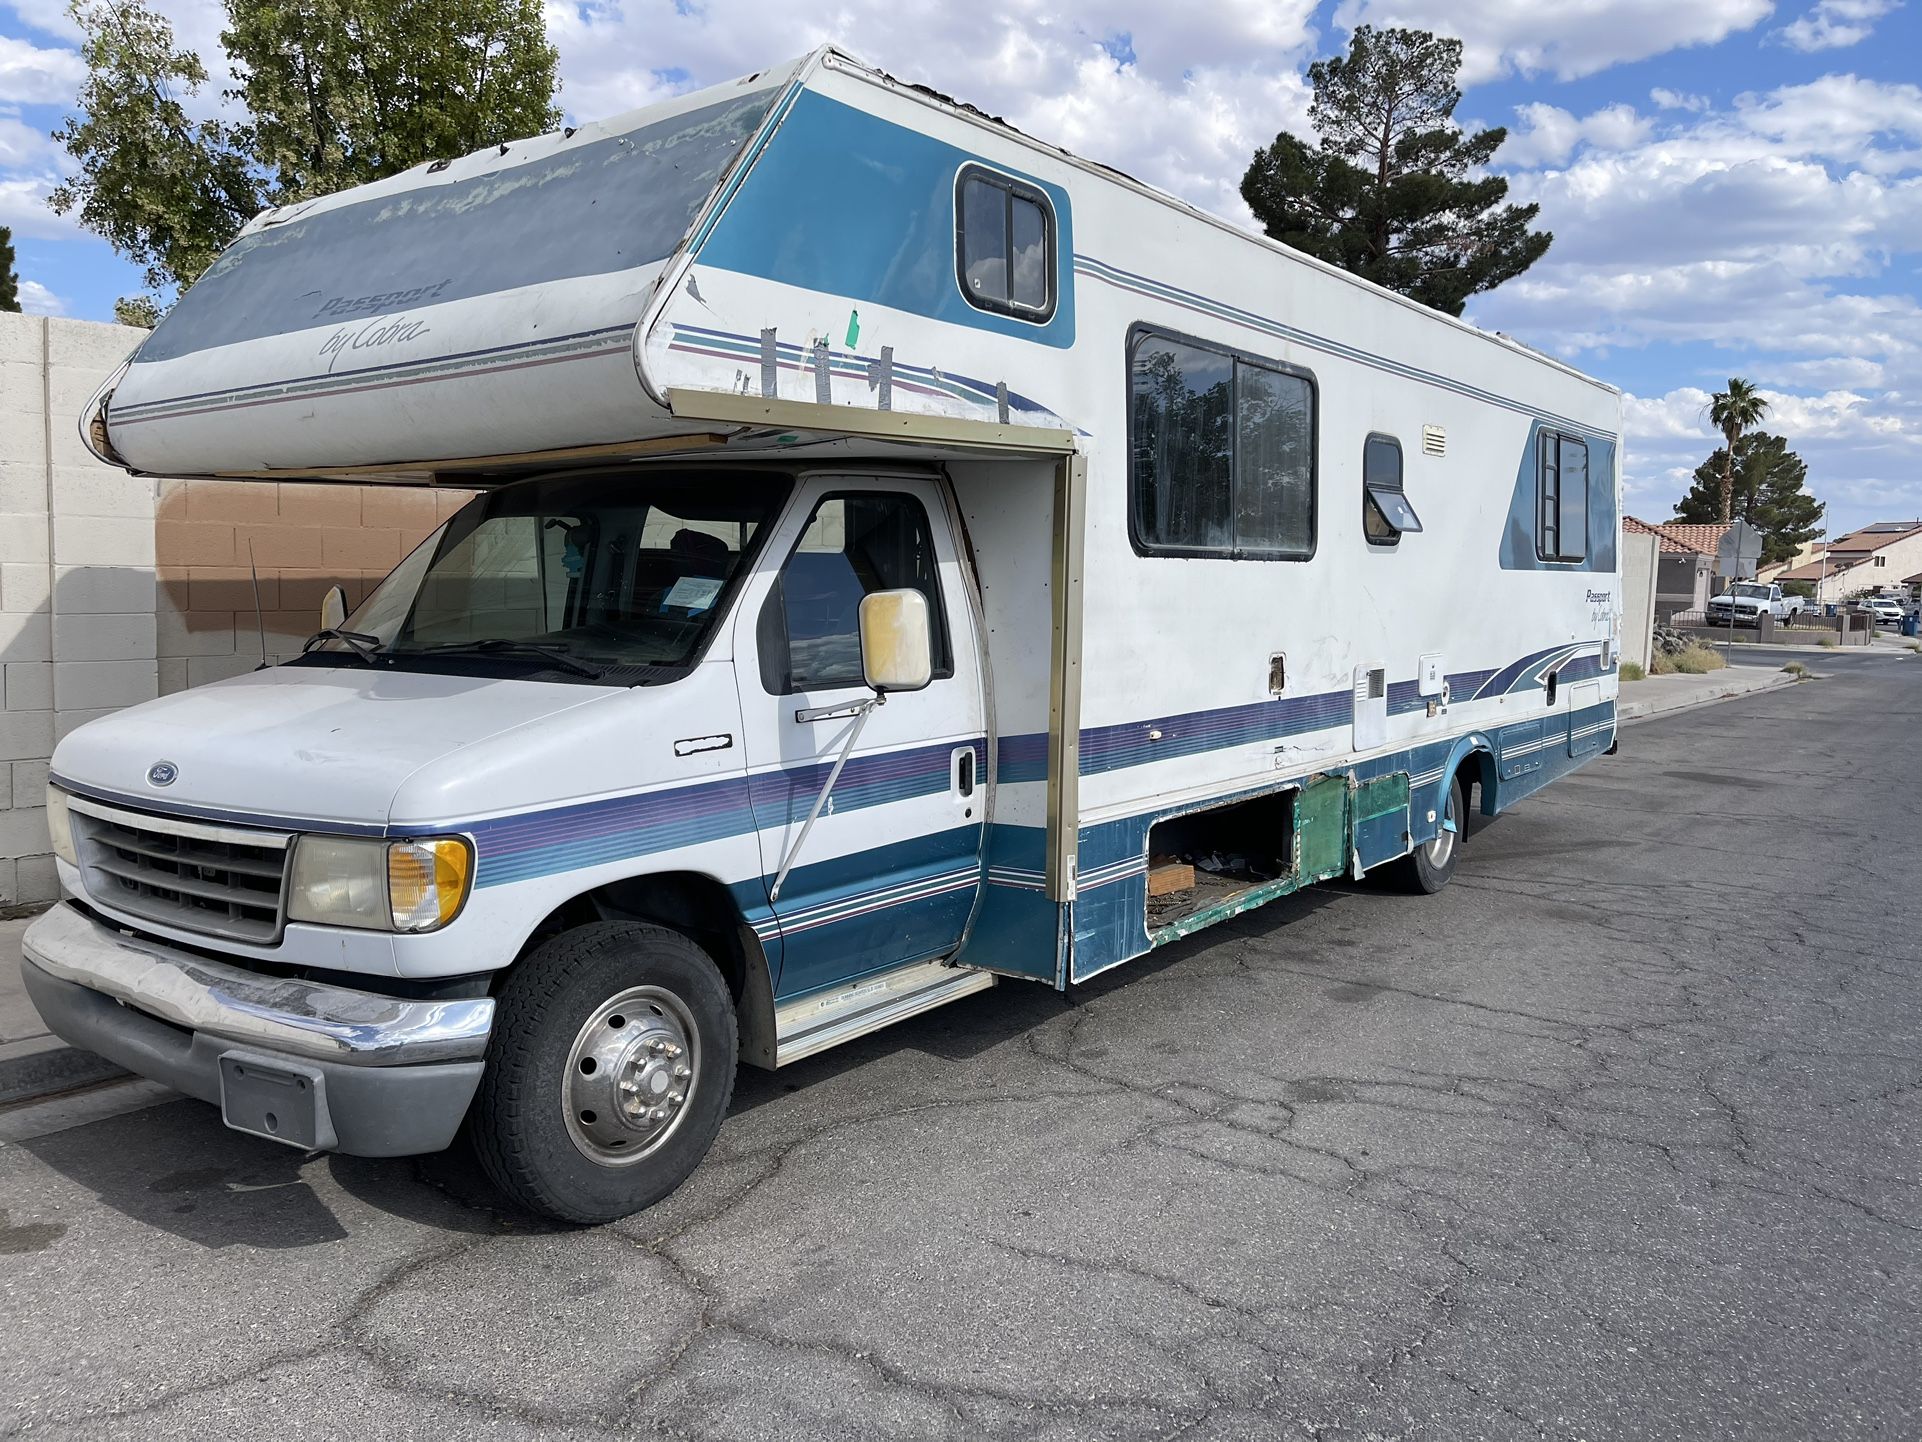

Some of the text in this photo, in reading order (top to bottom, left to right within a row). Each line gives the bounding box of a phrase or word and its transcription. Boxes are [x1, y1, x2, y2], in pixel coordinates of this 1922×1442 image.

[312, 279, 453, 319] Passport
[318, 314, 431, 373] by Cobra
[1585, 589, 1611, 605] Passport
